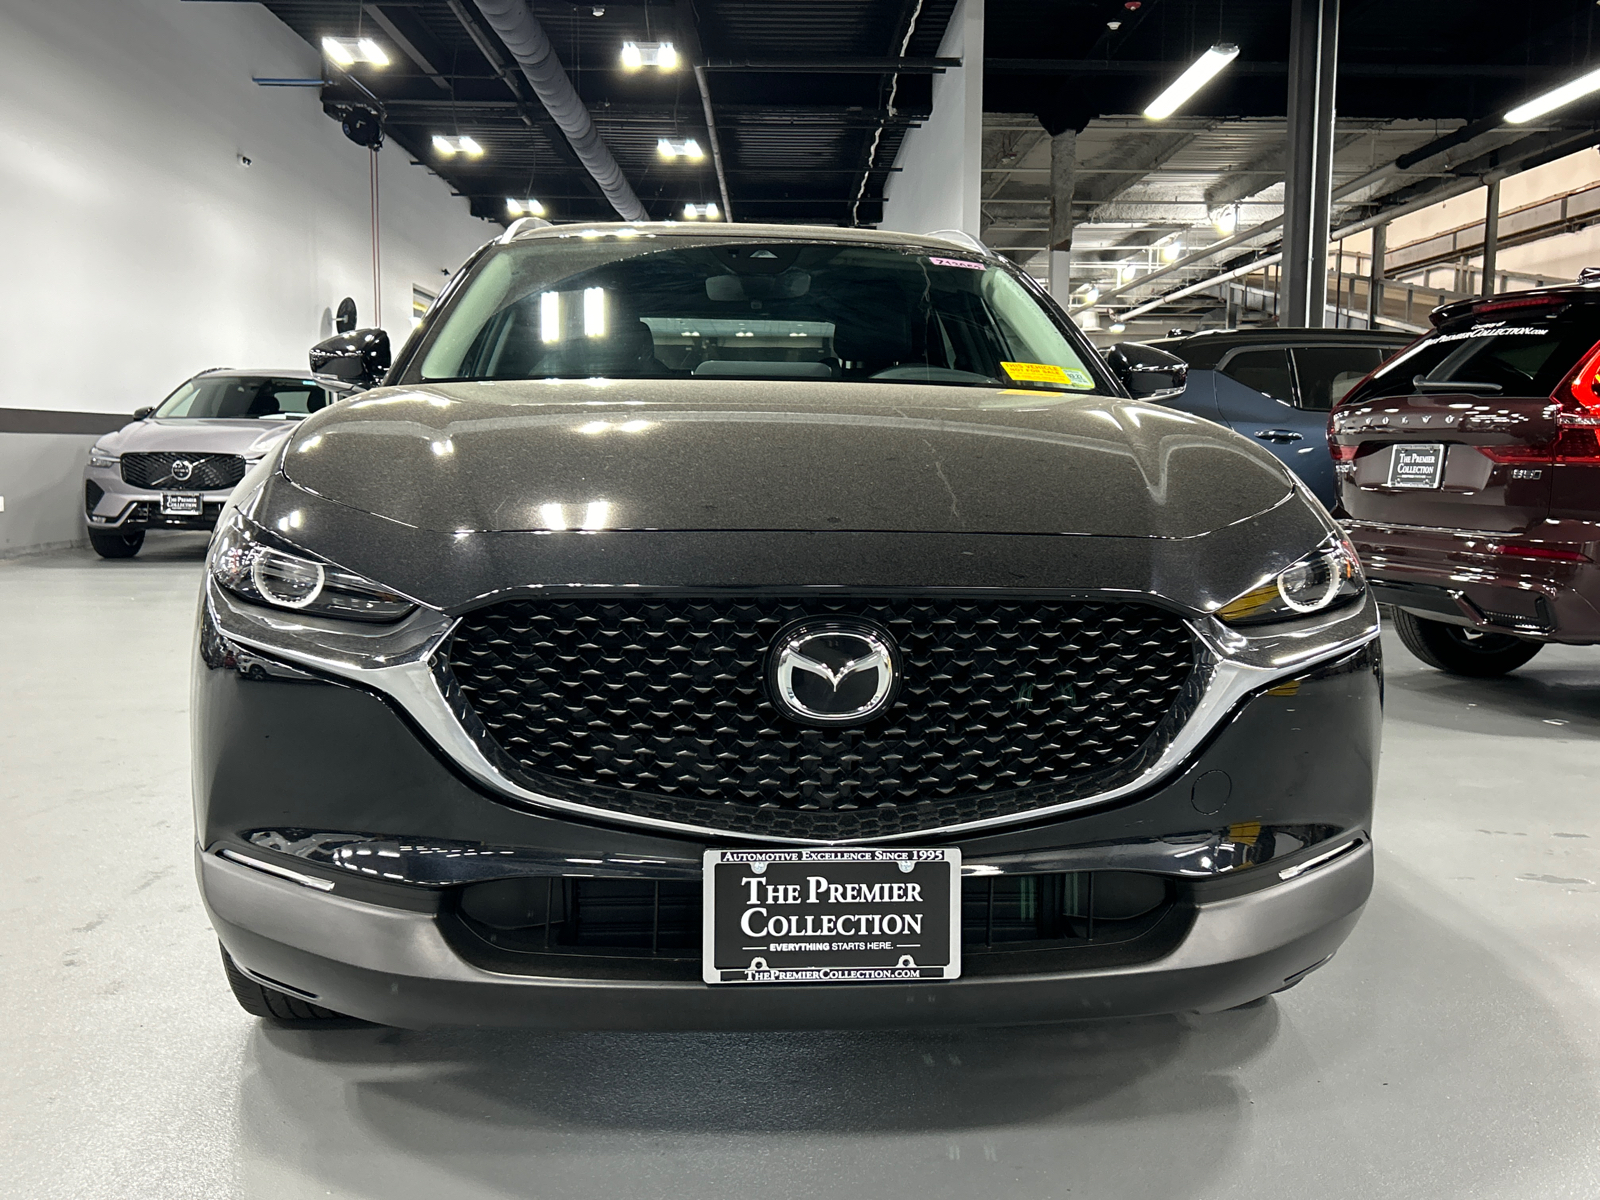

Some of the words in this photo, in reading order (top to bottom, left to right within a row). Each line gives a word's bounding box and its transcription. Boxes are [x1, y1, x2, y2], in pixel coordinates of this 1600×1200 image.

[1365, 416, 1455, 425] VOLVO
[1399, 453, 1411, 463] THE
[1412, 453, 1435, 463] PREMIER
[1397, 464, 1434, 474] COLLECTION
[722, 851, 799, 862] AUTOMOTIVE
[801, 851, 872, 861] EXCELLENCE
[874, 850, 909, 860] SINCE
[912, 850, 943, 860] 1995
[741, 876, 802, 905] THE
[806, 876, 923, 903] PREMIER
[740, 907, 923, 937] COLLECTION
[769, 942, 830, 951] EVERYTHING
[831, 942, 866, 950] STARTS
[867, 941, 894, 950] HERE.
